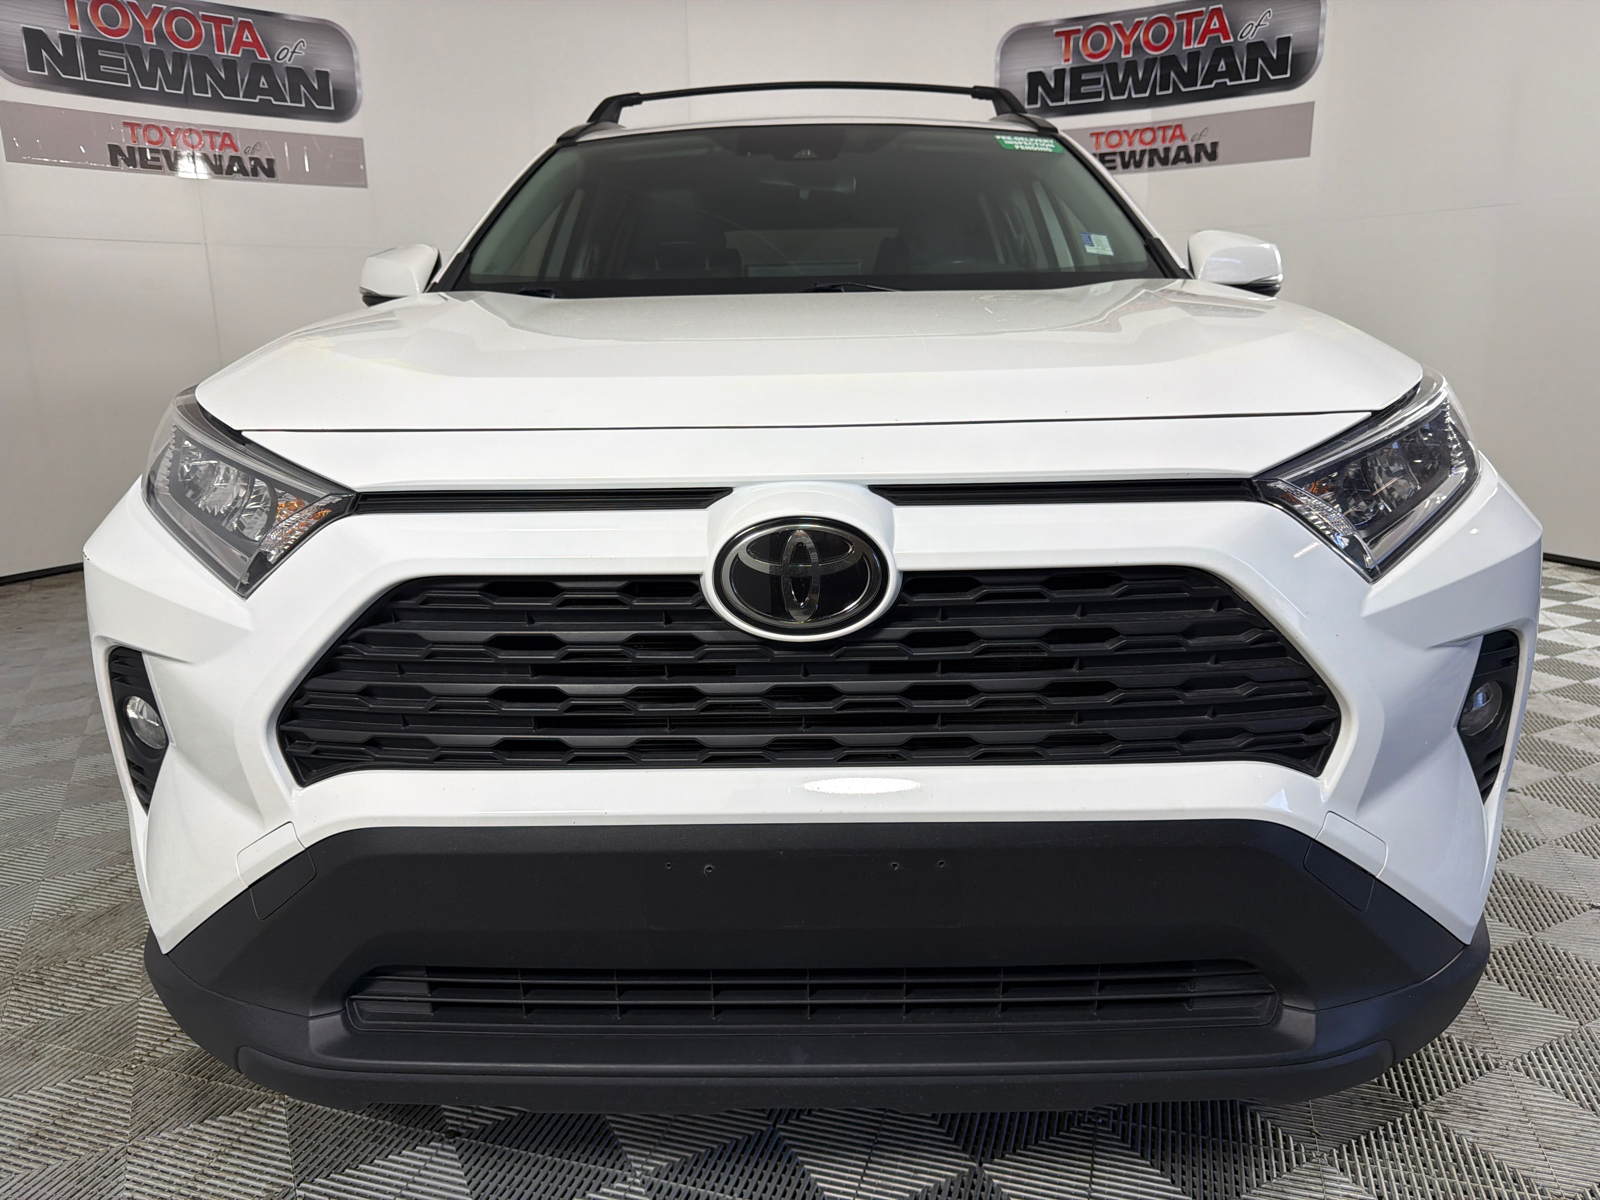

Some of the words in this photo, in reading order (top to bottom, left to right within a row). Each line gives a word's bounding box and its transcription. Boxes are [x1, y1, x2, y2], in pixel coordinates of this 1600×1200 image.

[63, 0, 270, 60] TOYOTA
[274, 40, 305, 64] of
[1053, 4, 1234, 65] TOYOTA
[1237, 9, 1273, 42] of
[21, 26, 335, 110] NEWNAN
[1026, 36, 1292, 108] NEWNAN
[122, 121, 239, 153] TOYOTA
[1089, 123, 1187, 150] TOYOTA
[1093, 141, 1219, 171] EWNAN
